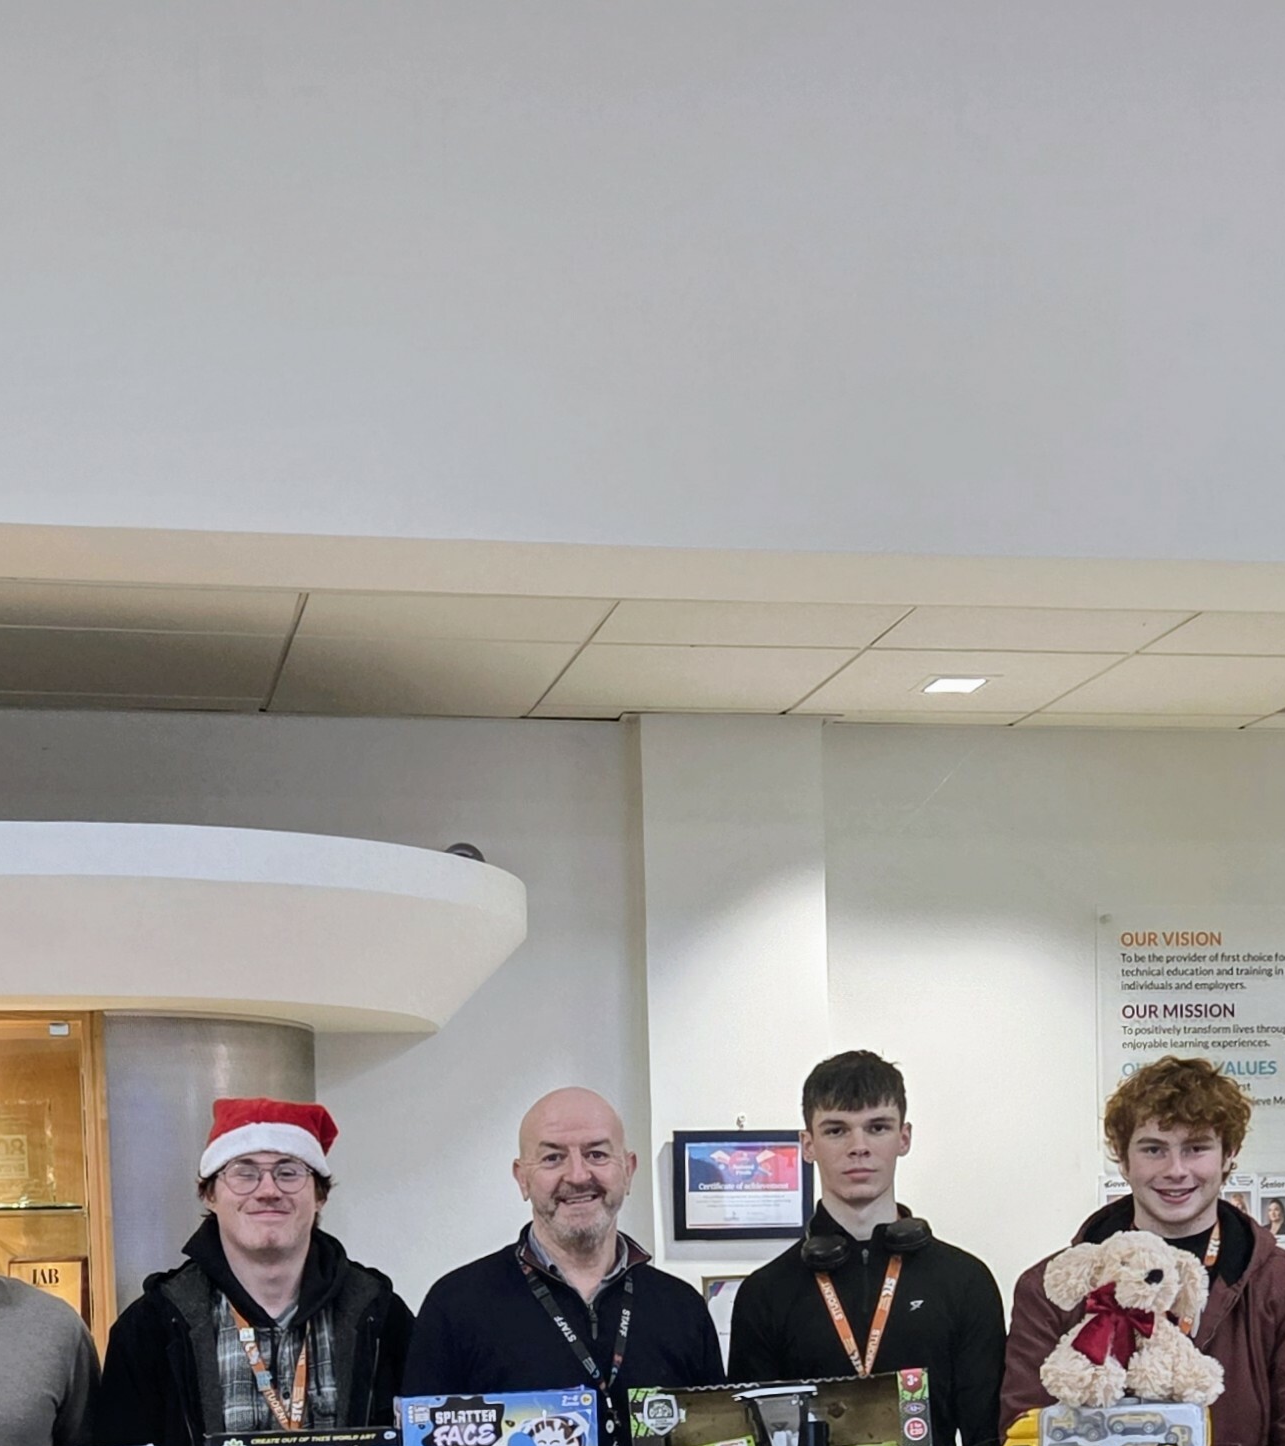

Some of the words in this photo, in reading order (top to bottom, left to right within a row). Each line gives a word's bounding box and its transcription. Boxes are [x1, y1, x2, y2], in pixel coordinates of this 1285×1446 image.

[1121, 932, 1157, 946] OUR
[1163, 932, 1221, 946] VISION
[1166, 953, 1209, 965] provider
[1242, 953, 1272, 963] choice
[1121, 967, 1164, 977] technical
[1166, 967, 1213, 977] education
[1236, 966, 1272, 978] training
[1121, 980, 1173, 991] individuals
[1194, 980, 1247, 992] employers.
[1122, 1005, 1159, 1018] OUR
[1163, 1004, 1235, 1018] MISSION
[1135, 1025, 1181, 1036] positively
[1183, 1024, 1231, 1034] transform
[1122, 1038, 1168, 1050] enjoyable
[1170, 1038, 1209, 1049] learning
[1211, 1037, 1271, 1048] experiences.
[435, 1410, 497, 1424] SPLATTER
[434, 1424, 497, 1446] FACE
